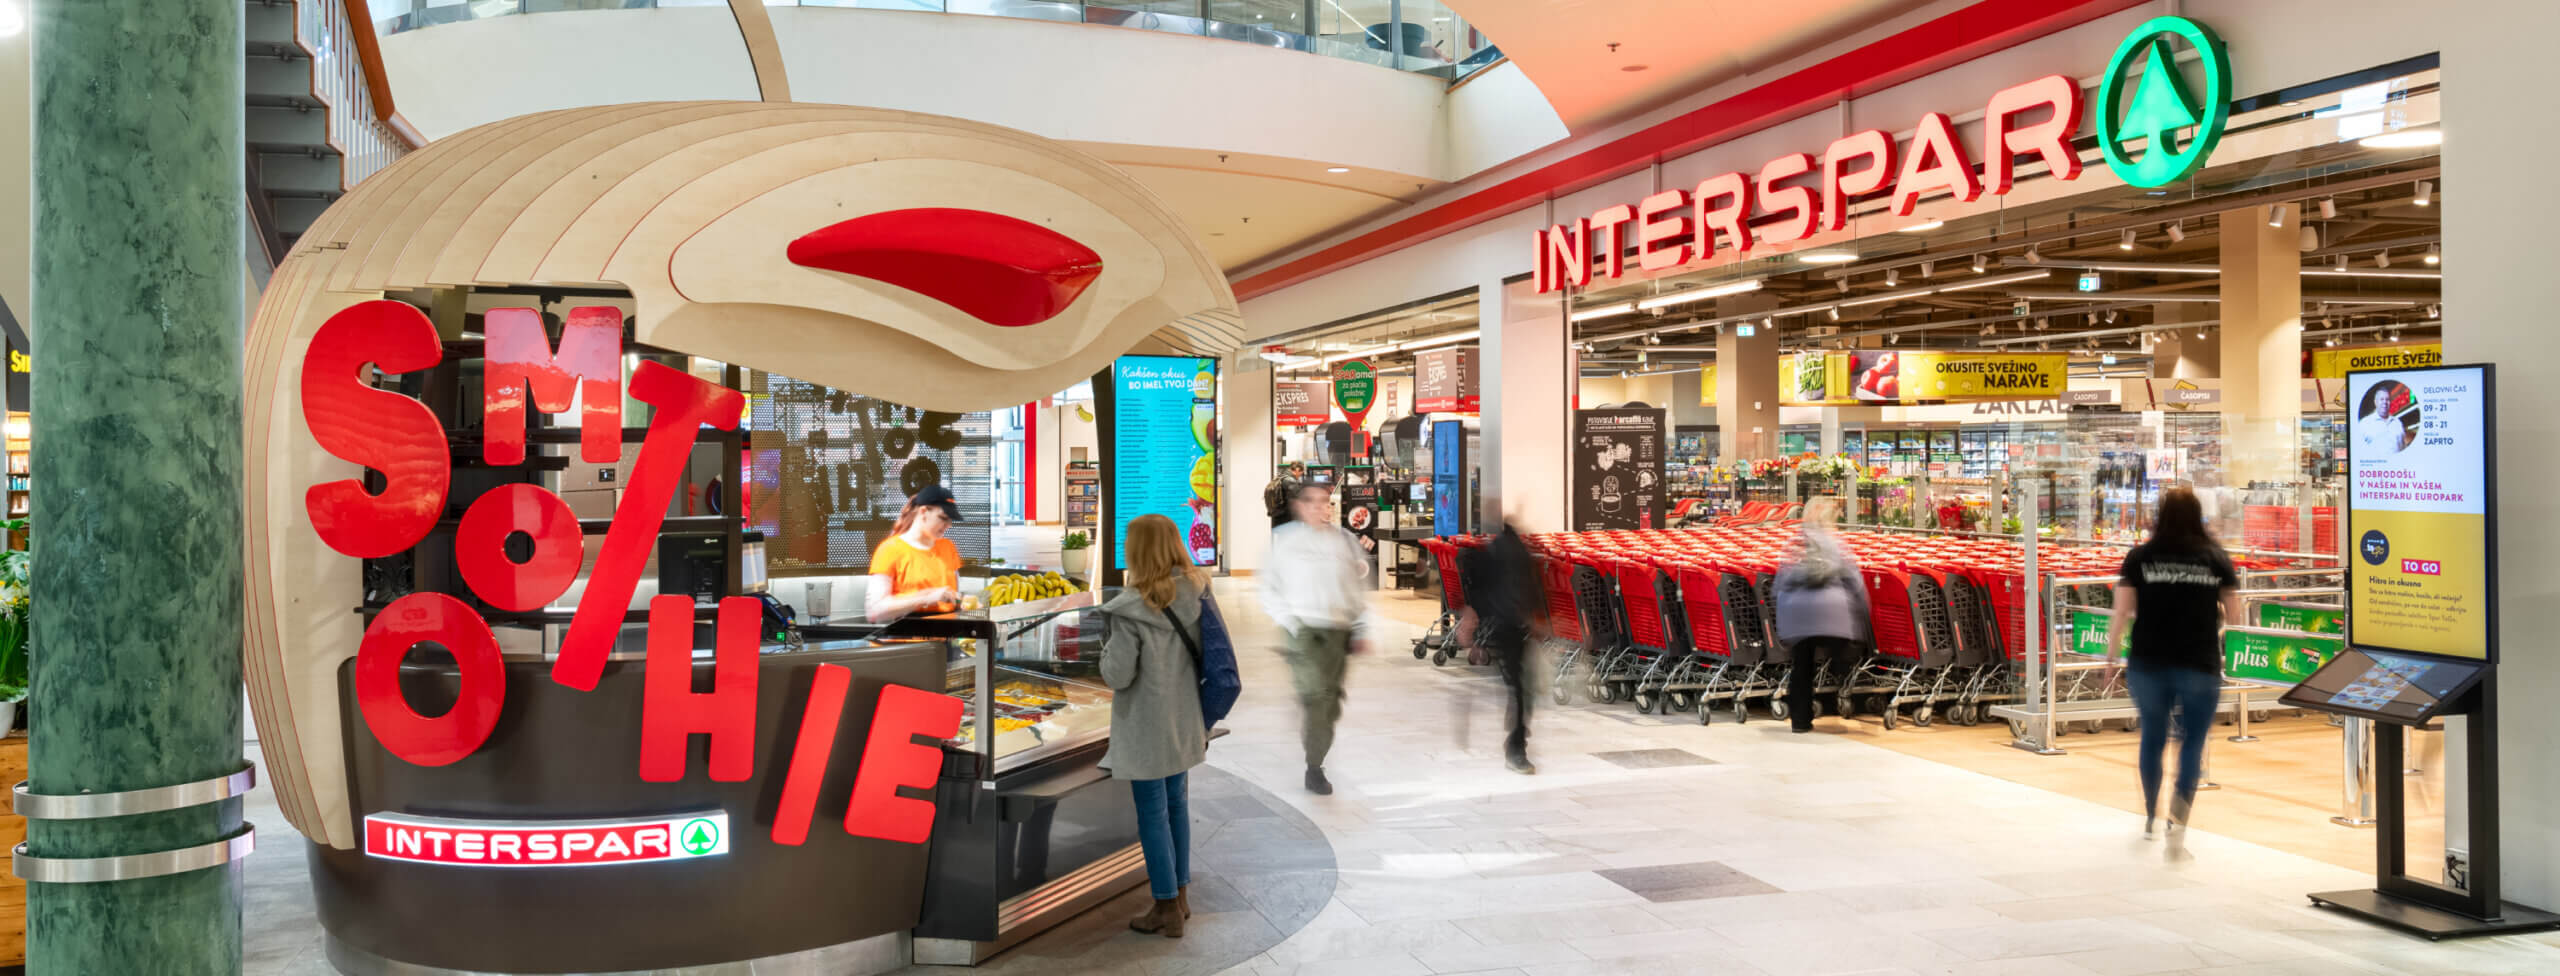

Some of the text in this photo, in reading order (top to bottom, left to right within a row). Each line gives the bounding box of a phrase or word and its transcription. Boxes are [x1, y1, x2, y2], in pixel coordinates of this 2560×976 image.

[1532, 73, 2083, 294] INTERSPAR
[1936, 360, 2038, 373] OKUSITE SVEŽINO
[2350, 354, 2400, 368] OKUSITE
[1128, 381, 1141, 390] BO
[1142, 380, 1164, 389] IMEL
[1164, 380, 1184, 388] TVOJ
[1984, 374, 2049, 388] NARAVE
[2424, 384, 2467, 394] DELOVNI ČAS
[1276, 392, 1310, 406] EKSPRES
[2180, 391, 2210, 400] ČASOPISI
[2424, 404, 2433, 412] 09
[2440, 404, 2447, 412] 21
[1300, 416, 1307, 424] 10
[2424, 437, 2454, 445] ZAPRTO
[2360, 468, 2416, 479] DOBRODOŠLI
[2368, 480, 2397, 489] NAŠEM
[2412, 480, 2442, 490] VAŠEM
[2360, 492, 2464, 502] INTERSPARU EUROPARK
[2404, 561, 2438, 573] TO GO
[2369, 576, 2422, 588] Hitro in okusno
[2080, 624, 2111, 649] plus
[2232, 645, 2269, 672] plus
[386, 822, 668, 861] INTERSPAR
